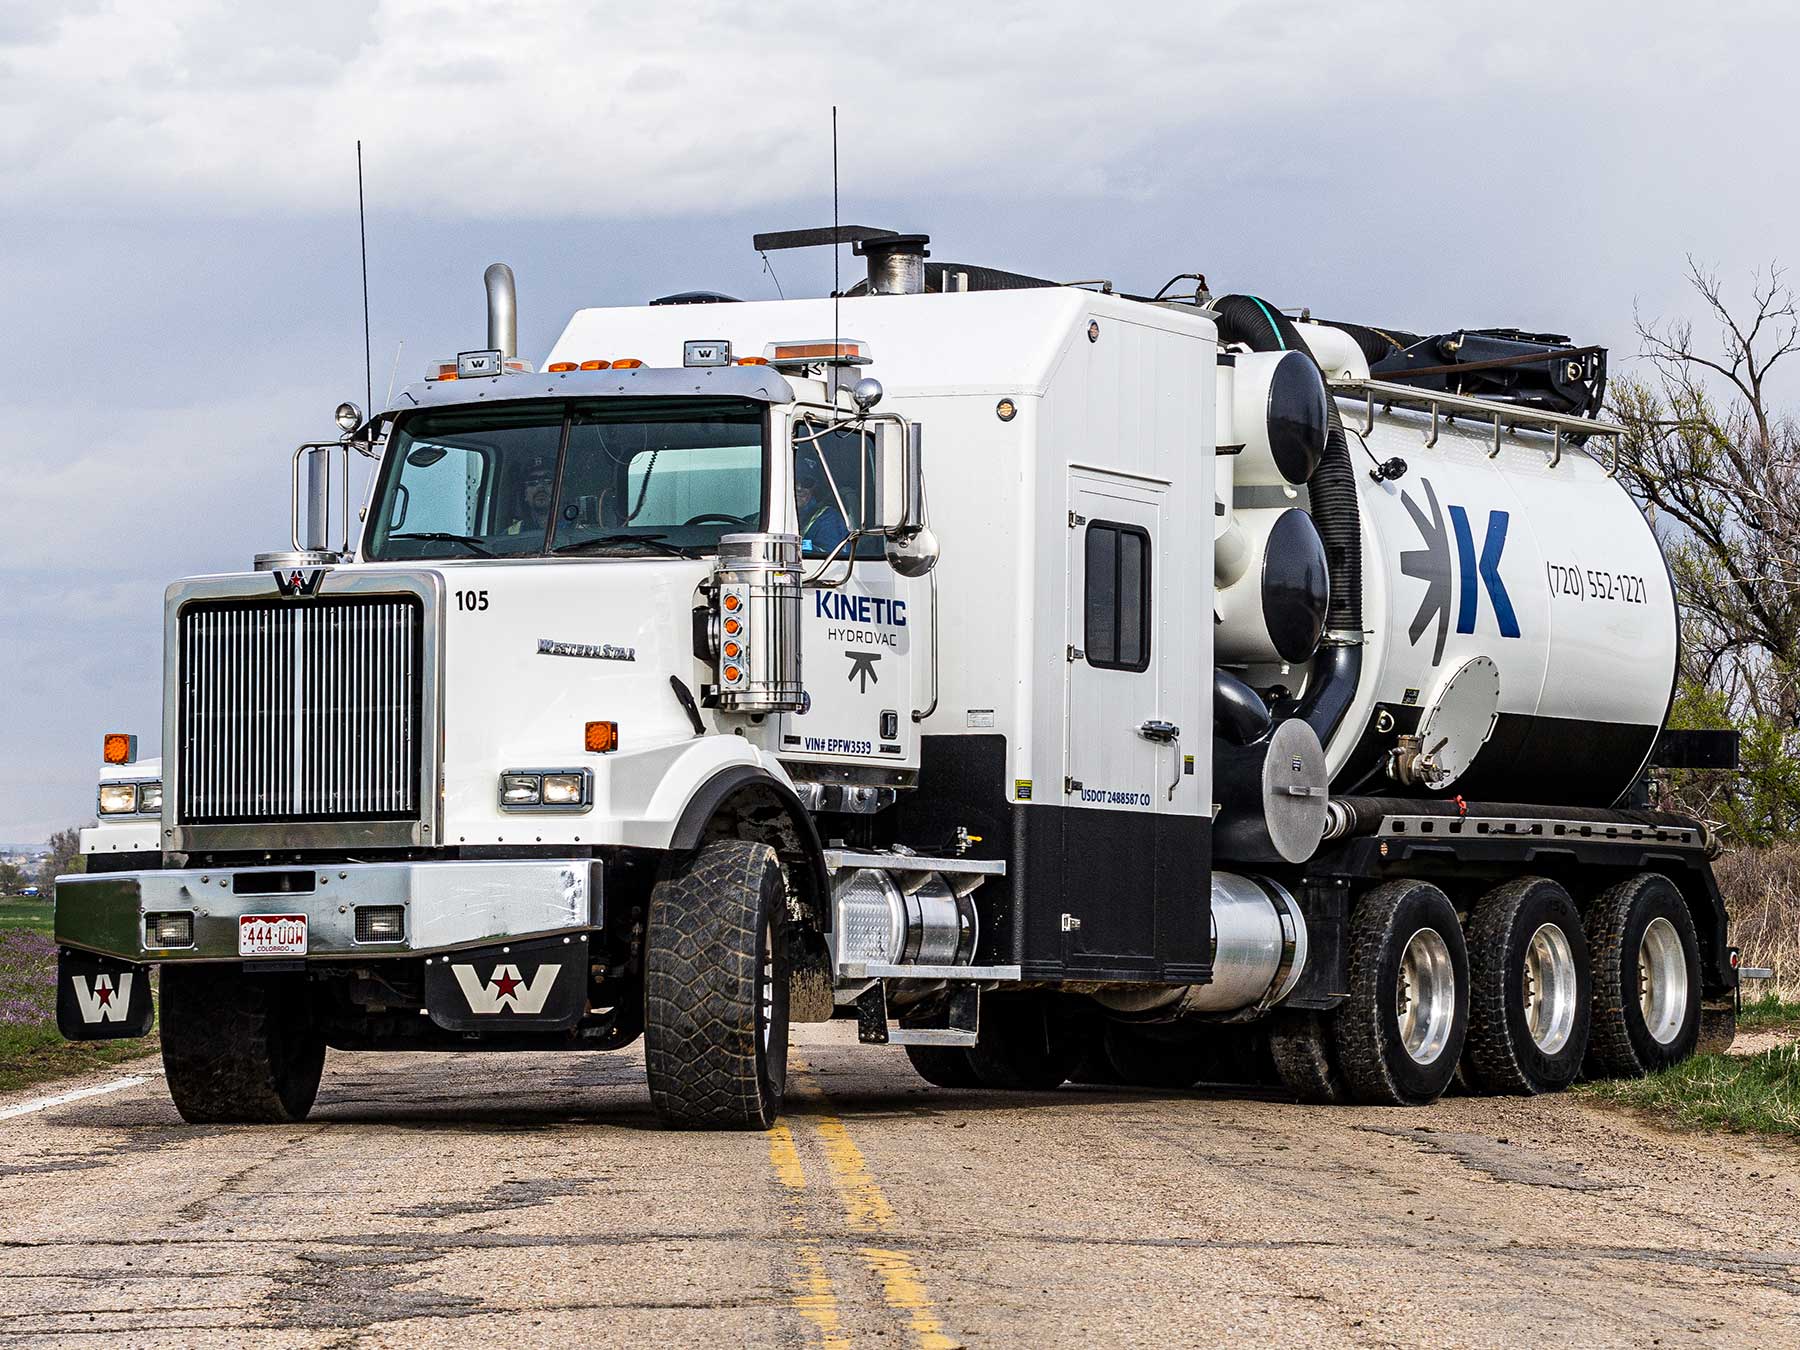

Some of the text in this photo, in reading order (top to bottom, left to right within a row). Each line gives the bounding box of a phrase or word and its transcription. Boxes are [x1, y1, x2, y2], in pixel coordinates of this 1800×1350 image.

[1448, 505, 1521, 638] K
[1547, 561, 1647, 604] (720) 552-1221
[455, 590, 489, 611] 105
[816, 590, 907, 626] KINETIC
[828, 628, 897, 646] HYDROVAC
[805, 737, 826, 751] VIN#
[827, 738, 871, 754] EPFW3539
[1081, 788, 1150, 806] USDOT 2488587 CO
[72, 973, 133, 1023] W
[451, 964, 562, 1014] W
